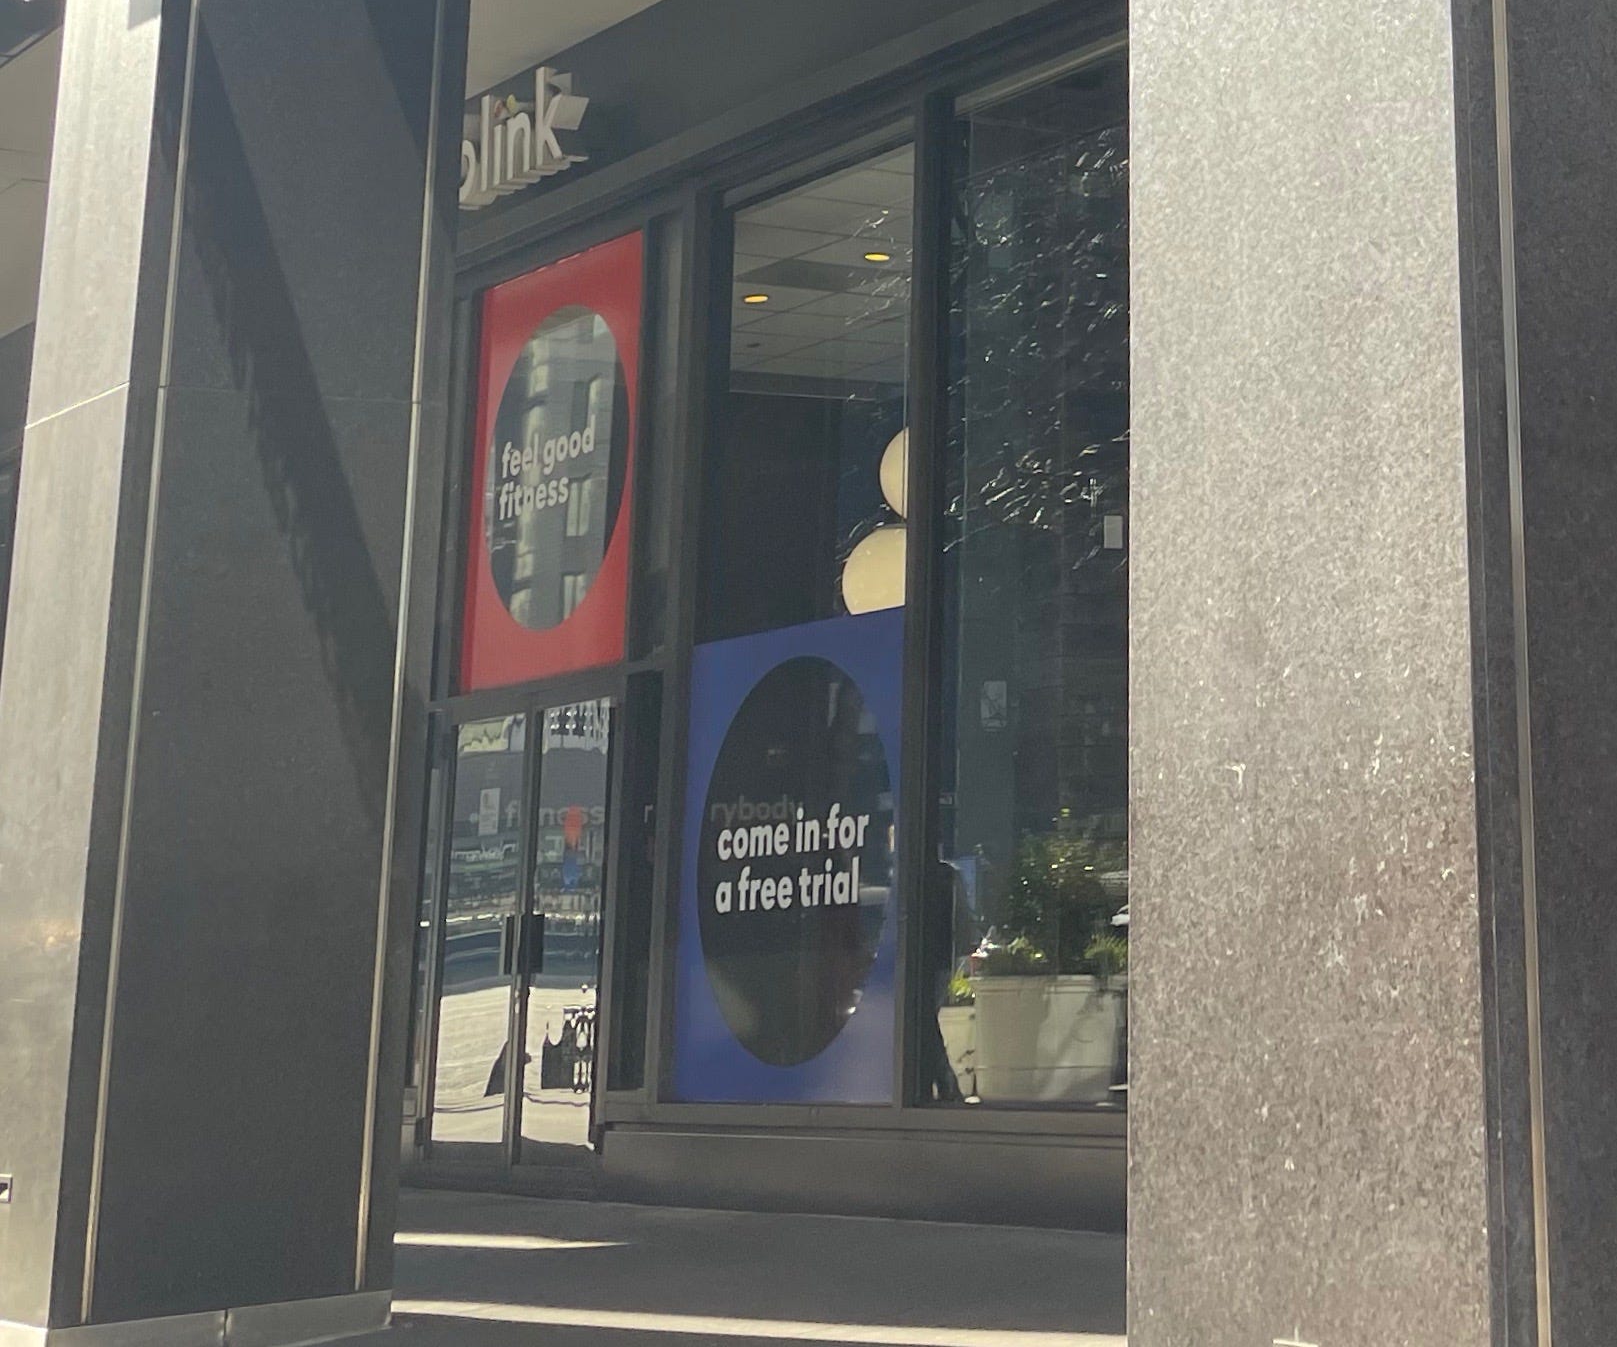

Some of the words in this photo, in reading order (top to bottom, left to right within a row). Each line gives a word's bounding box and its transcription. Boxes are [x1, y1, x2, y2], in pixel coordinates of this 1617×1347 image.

[501, 431, 539, 479] feel
[543, 413, 597, 477] good
[498, 476, 570, 522] fitness
[717, 822, 790, 861] come
[795, 807, 820, 853] in
[826, 802, 870, 850] for
[715, 882, 732, 914] a
[737, 865, 794, 912] free
[798, 856, 860, 908] trial
